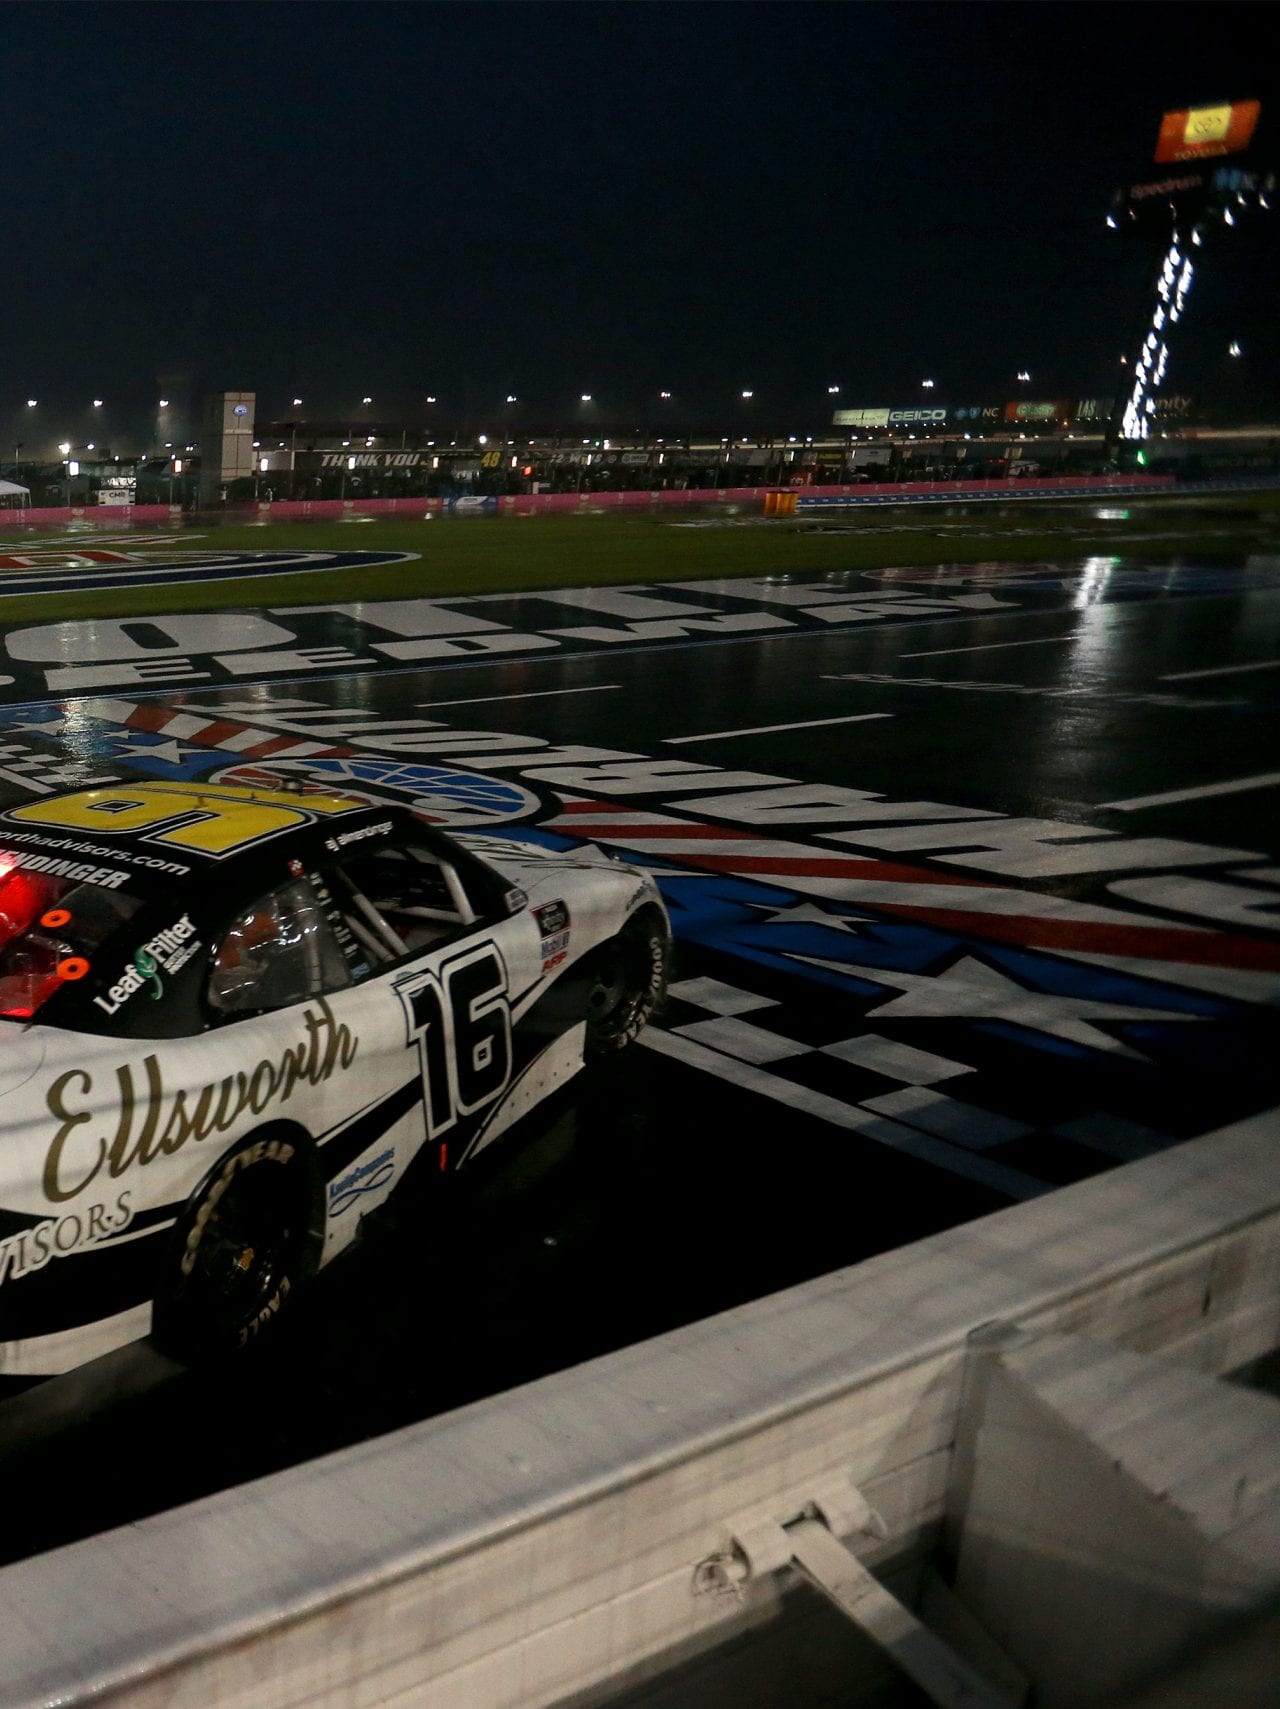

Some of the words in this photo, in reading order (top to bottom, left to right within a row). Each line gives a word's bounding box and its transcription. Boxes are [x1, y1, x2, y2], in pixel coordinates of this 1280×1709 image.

[890, 409, 947, 421] GEICO
[384, 453, 421, 466] YOU
[481, 451, 501, 468] 48
[93, 964, 146, 1015] Leaf
[144, 913, 197, 964] Filter
[391, 938, 513, 1141] 16
[42, 997, 360, 1203] Ellsworth
